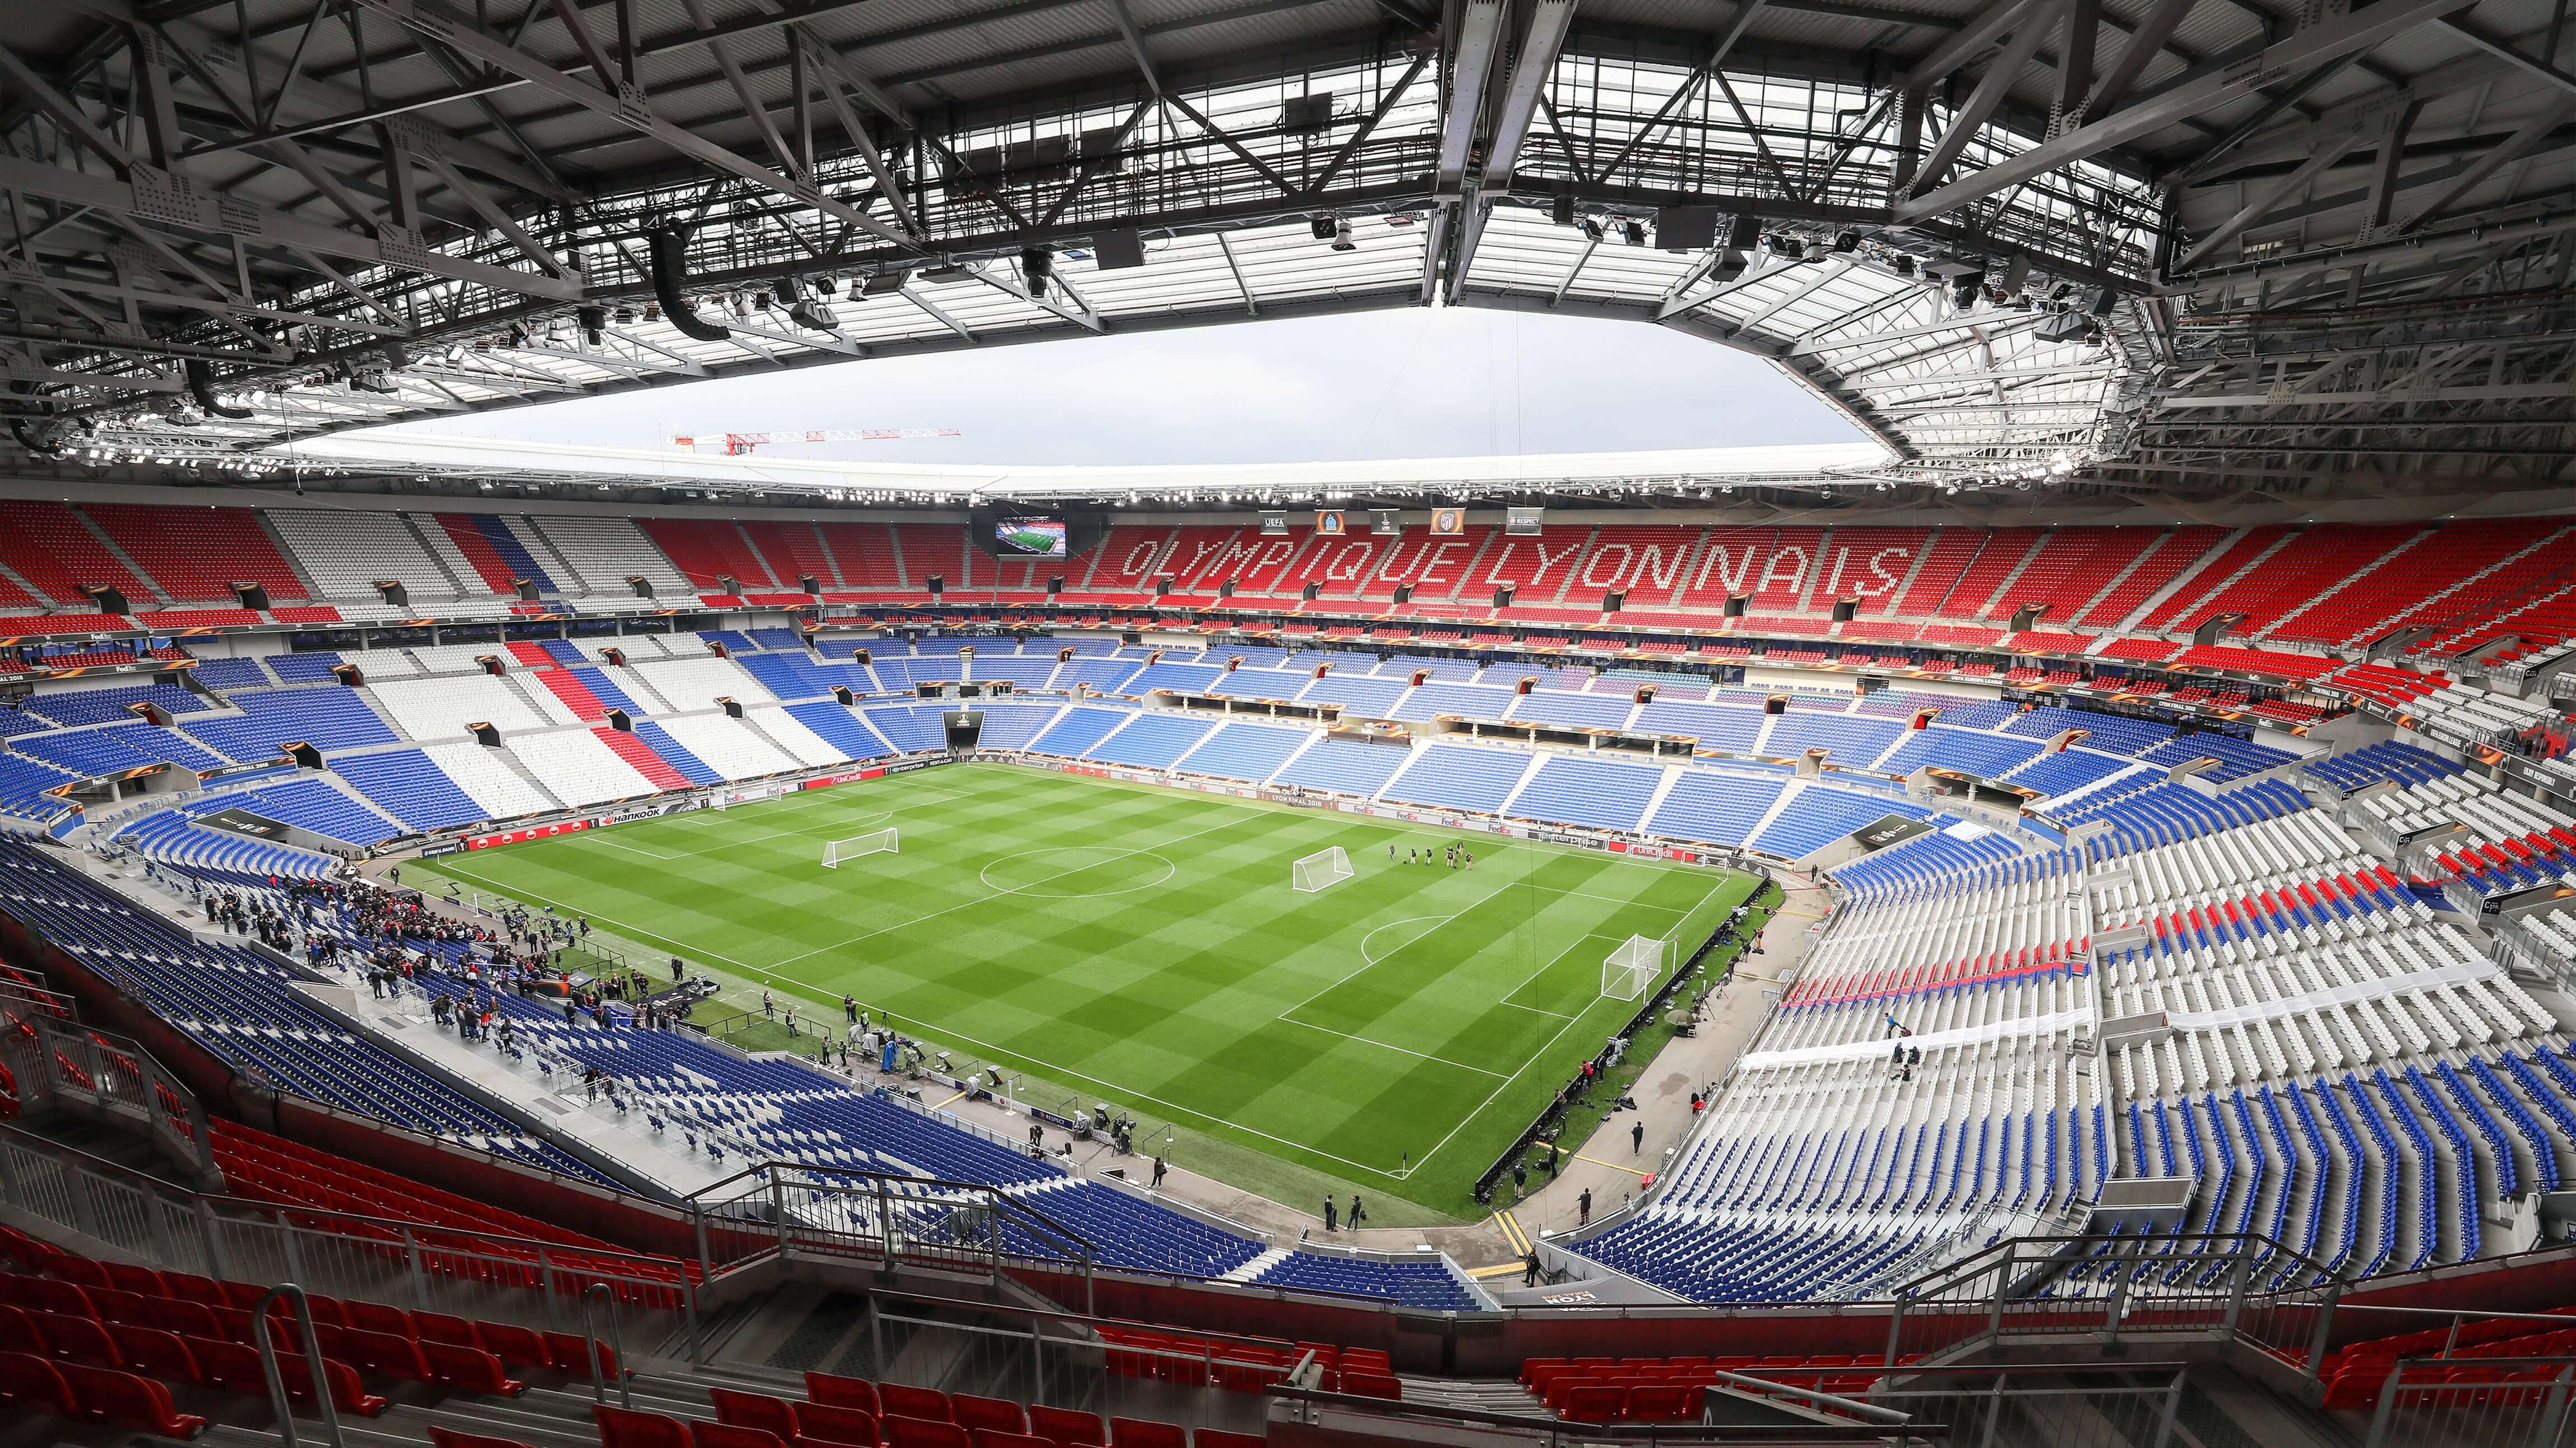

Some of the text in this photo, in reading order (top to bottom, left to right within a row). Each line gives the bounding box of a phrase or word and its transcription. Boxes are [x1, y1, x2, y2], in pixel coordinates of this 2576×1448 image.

[1264, 518, 1285, 526] UEFA
[1122, 541, 1908, 596] OLYMPIQUE LYONNAIS
[891, 757, 952, 773] enterprise RENT-A-CAR
[1852, 768, 1872, 776] EUROPA
[837, 772, 861, 783] UniCredit
[1155, 778, 1171, 787] FedEx
[1189, 783, 1207, 791] FedEx
[1225, 788, 1244, 797] FedEx
[725, 794, 745, 803] FedEx
[1354, 806, 1374, 815] FedEx
[614, 809, 660, 823] HANKOOK
[1396, 811, 1418, 821] FedEx
[1441, 818, 1463, 828] FedEx
[1488, 824, 1513, 835] FedEx
[932, 1074, 947, 1082] RESPECT
[1045, 1114, 1064, 1125] RESPECT
[1544, 1293, 1597, 1304] LYON
